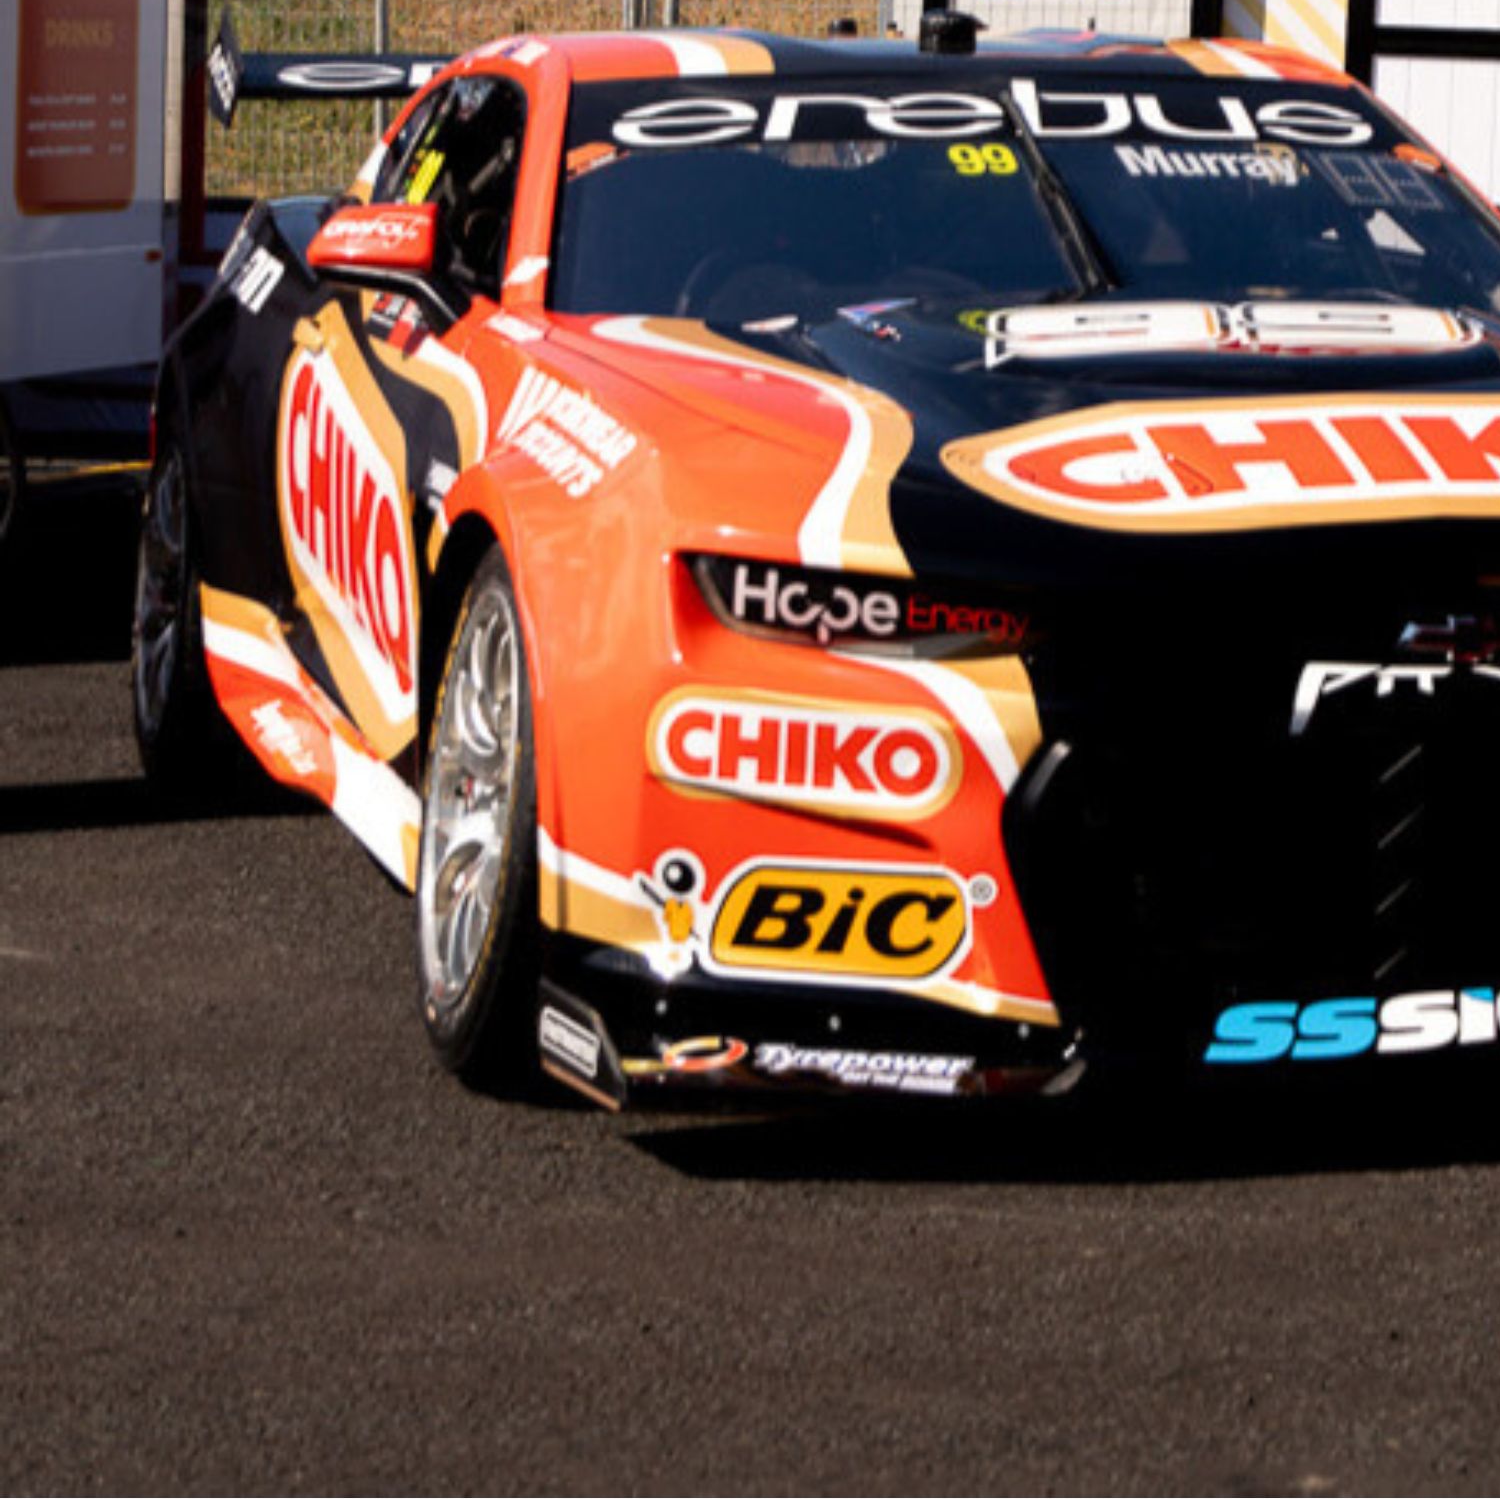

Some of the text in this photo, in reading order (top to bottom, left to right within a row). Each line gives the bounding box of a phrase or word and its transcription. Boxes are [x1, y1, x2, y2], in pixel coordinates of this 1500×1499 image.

[45, 19, 115, 48] DRINKS
[611, 78, 1373, 148] erebus
[947, 142, 1019, 177] 99
[1113, 143, 1299, 187] Murray
[287, 361, 414, 696] CHIKO
[733, 565, 1030, 642] Hope Energy
[666, 709, 939, 797] CHIKO
[754, 1042, 976, 1075] Tyrepower
